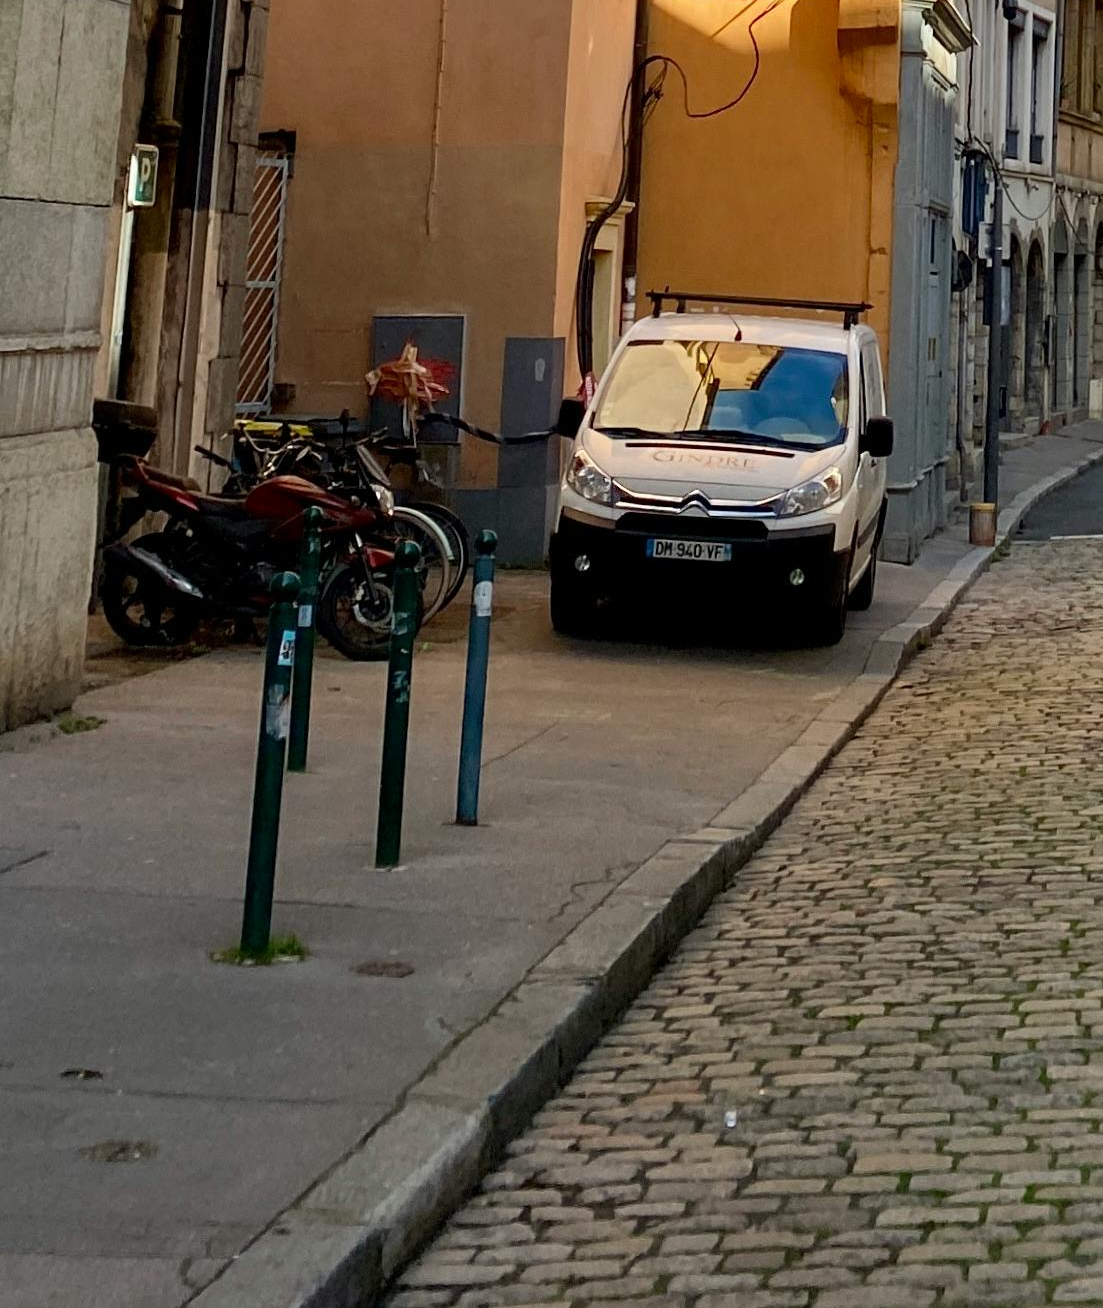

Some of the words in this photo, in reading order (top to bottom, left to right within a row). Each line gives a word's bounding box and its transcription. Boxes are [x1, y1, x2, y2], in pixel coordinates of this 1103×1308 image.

[655, 541, 673, 556] DM
[676, 543, 702, 558] 940
[707, 545, 724, 560] VF
